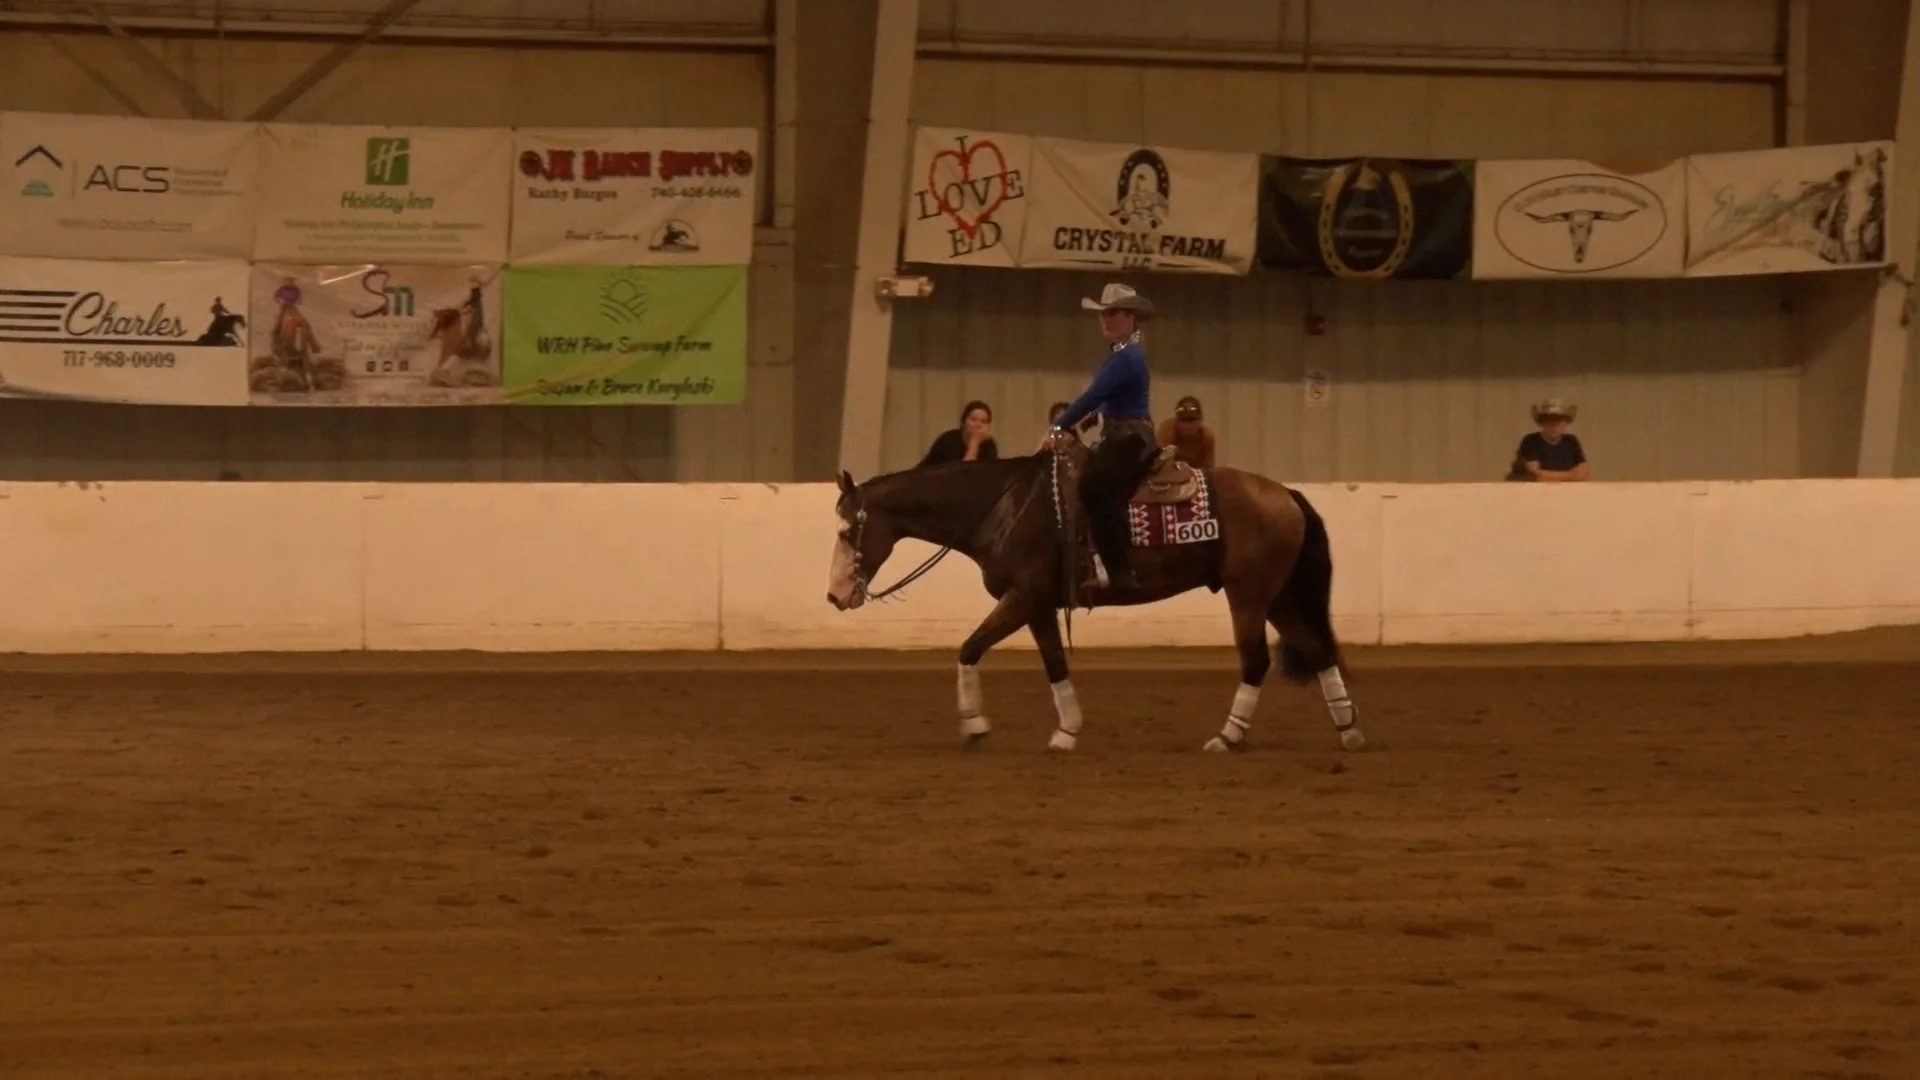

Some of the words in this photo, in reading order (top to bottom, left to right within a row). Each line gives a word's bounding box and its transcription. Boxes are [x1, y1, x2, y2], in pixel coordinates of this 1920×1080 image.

[955, 135, 970, 166] I
[83, 164, 169, 193] ACS
[340, 191, 403, 213] Holiday
[406, 191, 434, 210] Inn
[914, 169, 1025, 220] LOVE
[947, 220, 1003, 258] ED
[1054, 226, 1154, 255] CRYSTAL
[1159, 235, 1226, 259] FARM
[65, 291, 188, 338] Charles
[674, 335, 713, 352] Farm
[63, 351, 175, 368] 717-968-0009
[1179, 521, 1216, 540] 600
